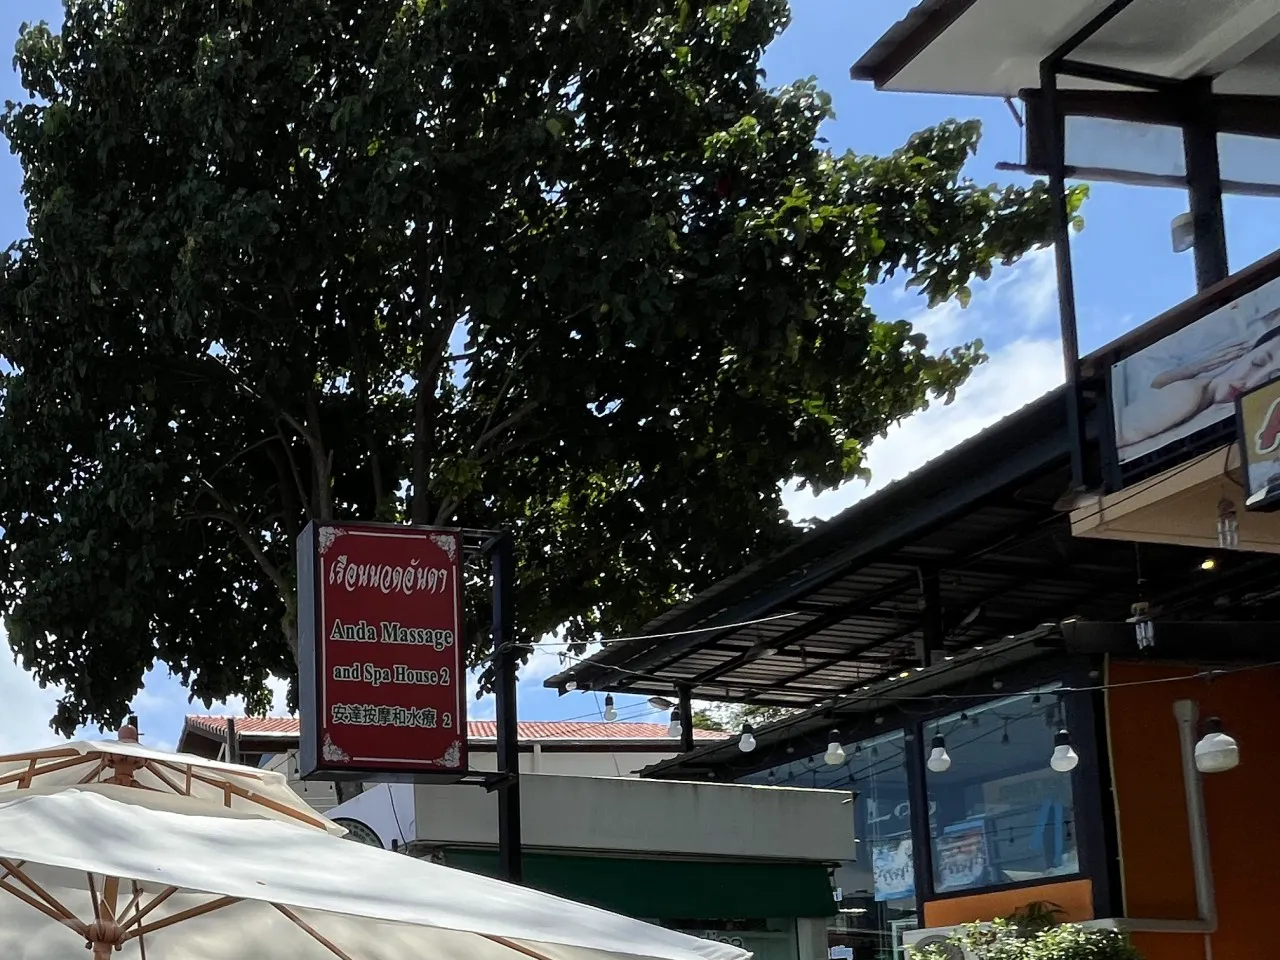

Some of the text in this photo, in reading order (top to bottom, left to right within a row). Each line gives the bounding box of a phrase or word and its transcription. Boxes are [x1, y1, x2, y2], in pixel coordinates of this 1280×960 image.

[329, 555, 448, 595] เรือนนวดอันดา
[330, 618, 453, 650] Anda Massage
[333, 663, 450, 686] and Spa House 2
[331, 703, 452, 728] 安達按摩和水療 2
